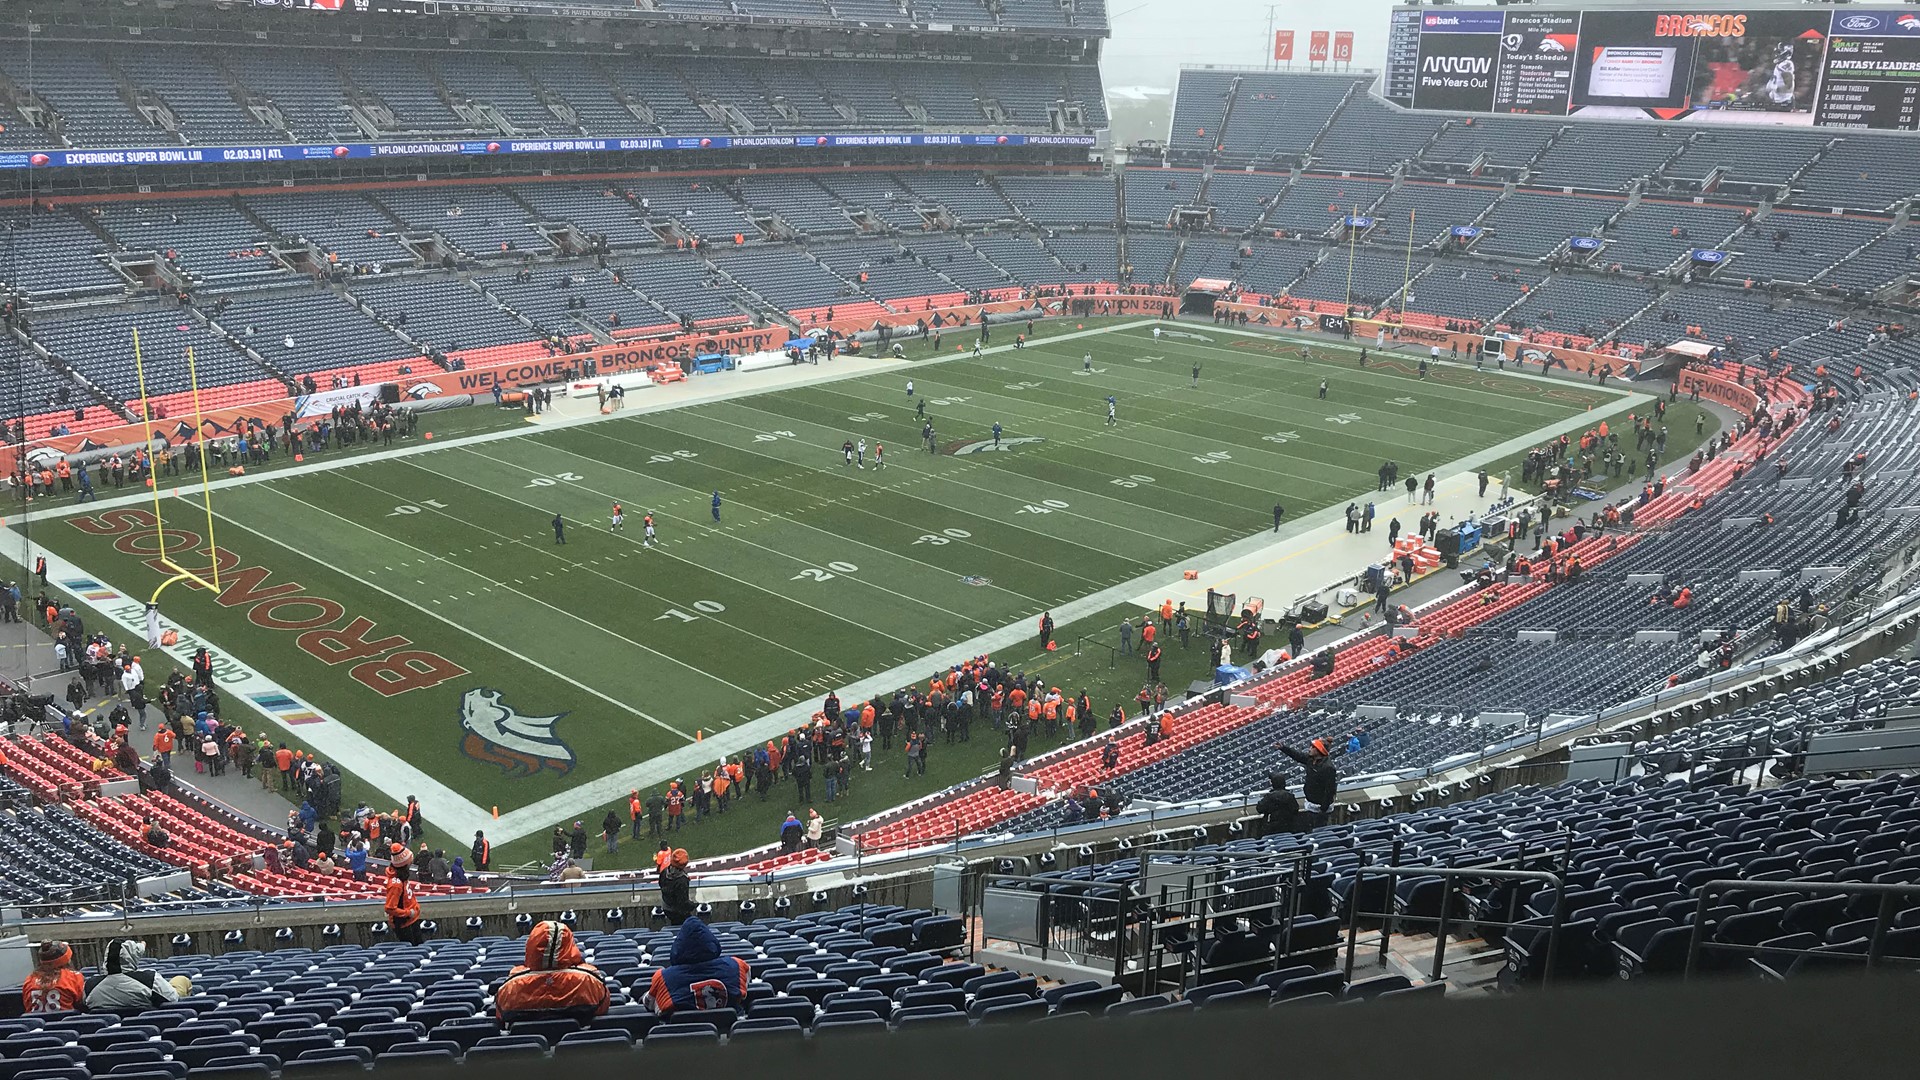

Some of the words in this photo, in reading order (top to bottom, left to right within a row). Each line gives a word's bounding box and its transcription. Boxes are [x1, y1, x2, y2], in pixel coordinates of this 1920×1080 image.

[1655, 14, 1747, 37] BRONCOS
[1280, 44, 1288, 56] 7
[1310, 44, 1326, 57] 44
[1336, 45, 1349, 57] 18
[1423, 56, 1492, 74] ARROW
[1830, 60, 1875, 69] FANTASY
[1876, 61, 1920, 70] LEADERS
[1422, 77, 1442, 86] Five
[1443, 78, 1468, 87] Years
[1470, 78, 1488, 88] Out
[511, 142, 551, 151] EXPERIENCE
[553, 142, 574, 150] SUPER
[575, 141, 595, 150] BOWL
[595, 141, 606, 149] LIII
[620, 139, 648, 149] 02.03.19
[652, 139, 663, 148] ATL
[733, 137, 795, 146] NFLONLOCATION.COM
[224, 149, 261, 160] 02.03.19
[268, 149, 283, 159] ATL
[378, 144, 458, 154] NFLONLOCATION.COM
[66, 153, 124, 164] EXPERIENCE
[127, 152, 158, 162] SUPER
[160, 151, 187, 162] BOWL
[189, 151, 202, 161] LIII
[459, 360, 564, 390] WELCOME
[602, 343, 690, 369] BRONCOS
[695, 333, 773, 353] COUNTRY
[1384, 397, 1417, 406] 10
[1325, 412, 1362, 424] 20
[1262, 431, 1300, 443] 30
[1192, 450, 1232, 463] 40
[1110, 474, 1155, 487] 50
[1024, 500, 1069, 514] 40
[919, 528, 972, 546] 30
[800, 562, 858, 581] 20
[64, 508, 472, 697] BRONCOS
[664, 600, 726, 622] 10
[171, 635, 253, 683] CRUIAL
[164, 735, 169, 743] 6
[671, 797, 680, 805] 27
[30, 990, 61, 1013] 58
